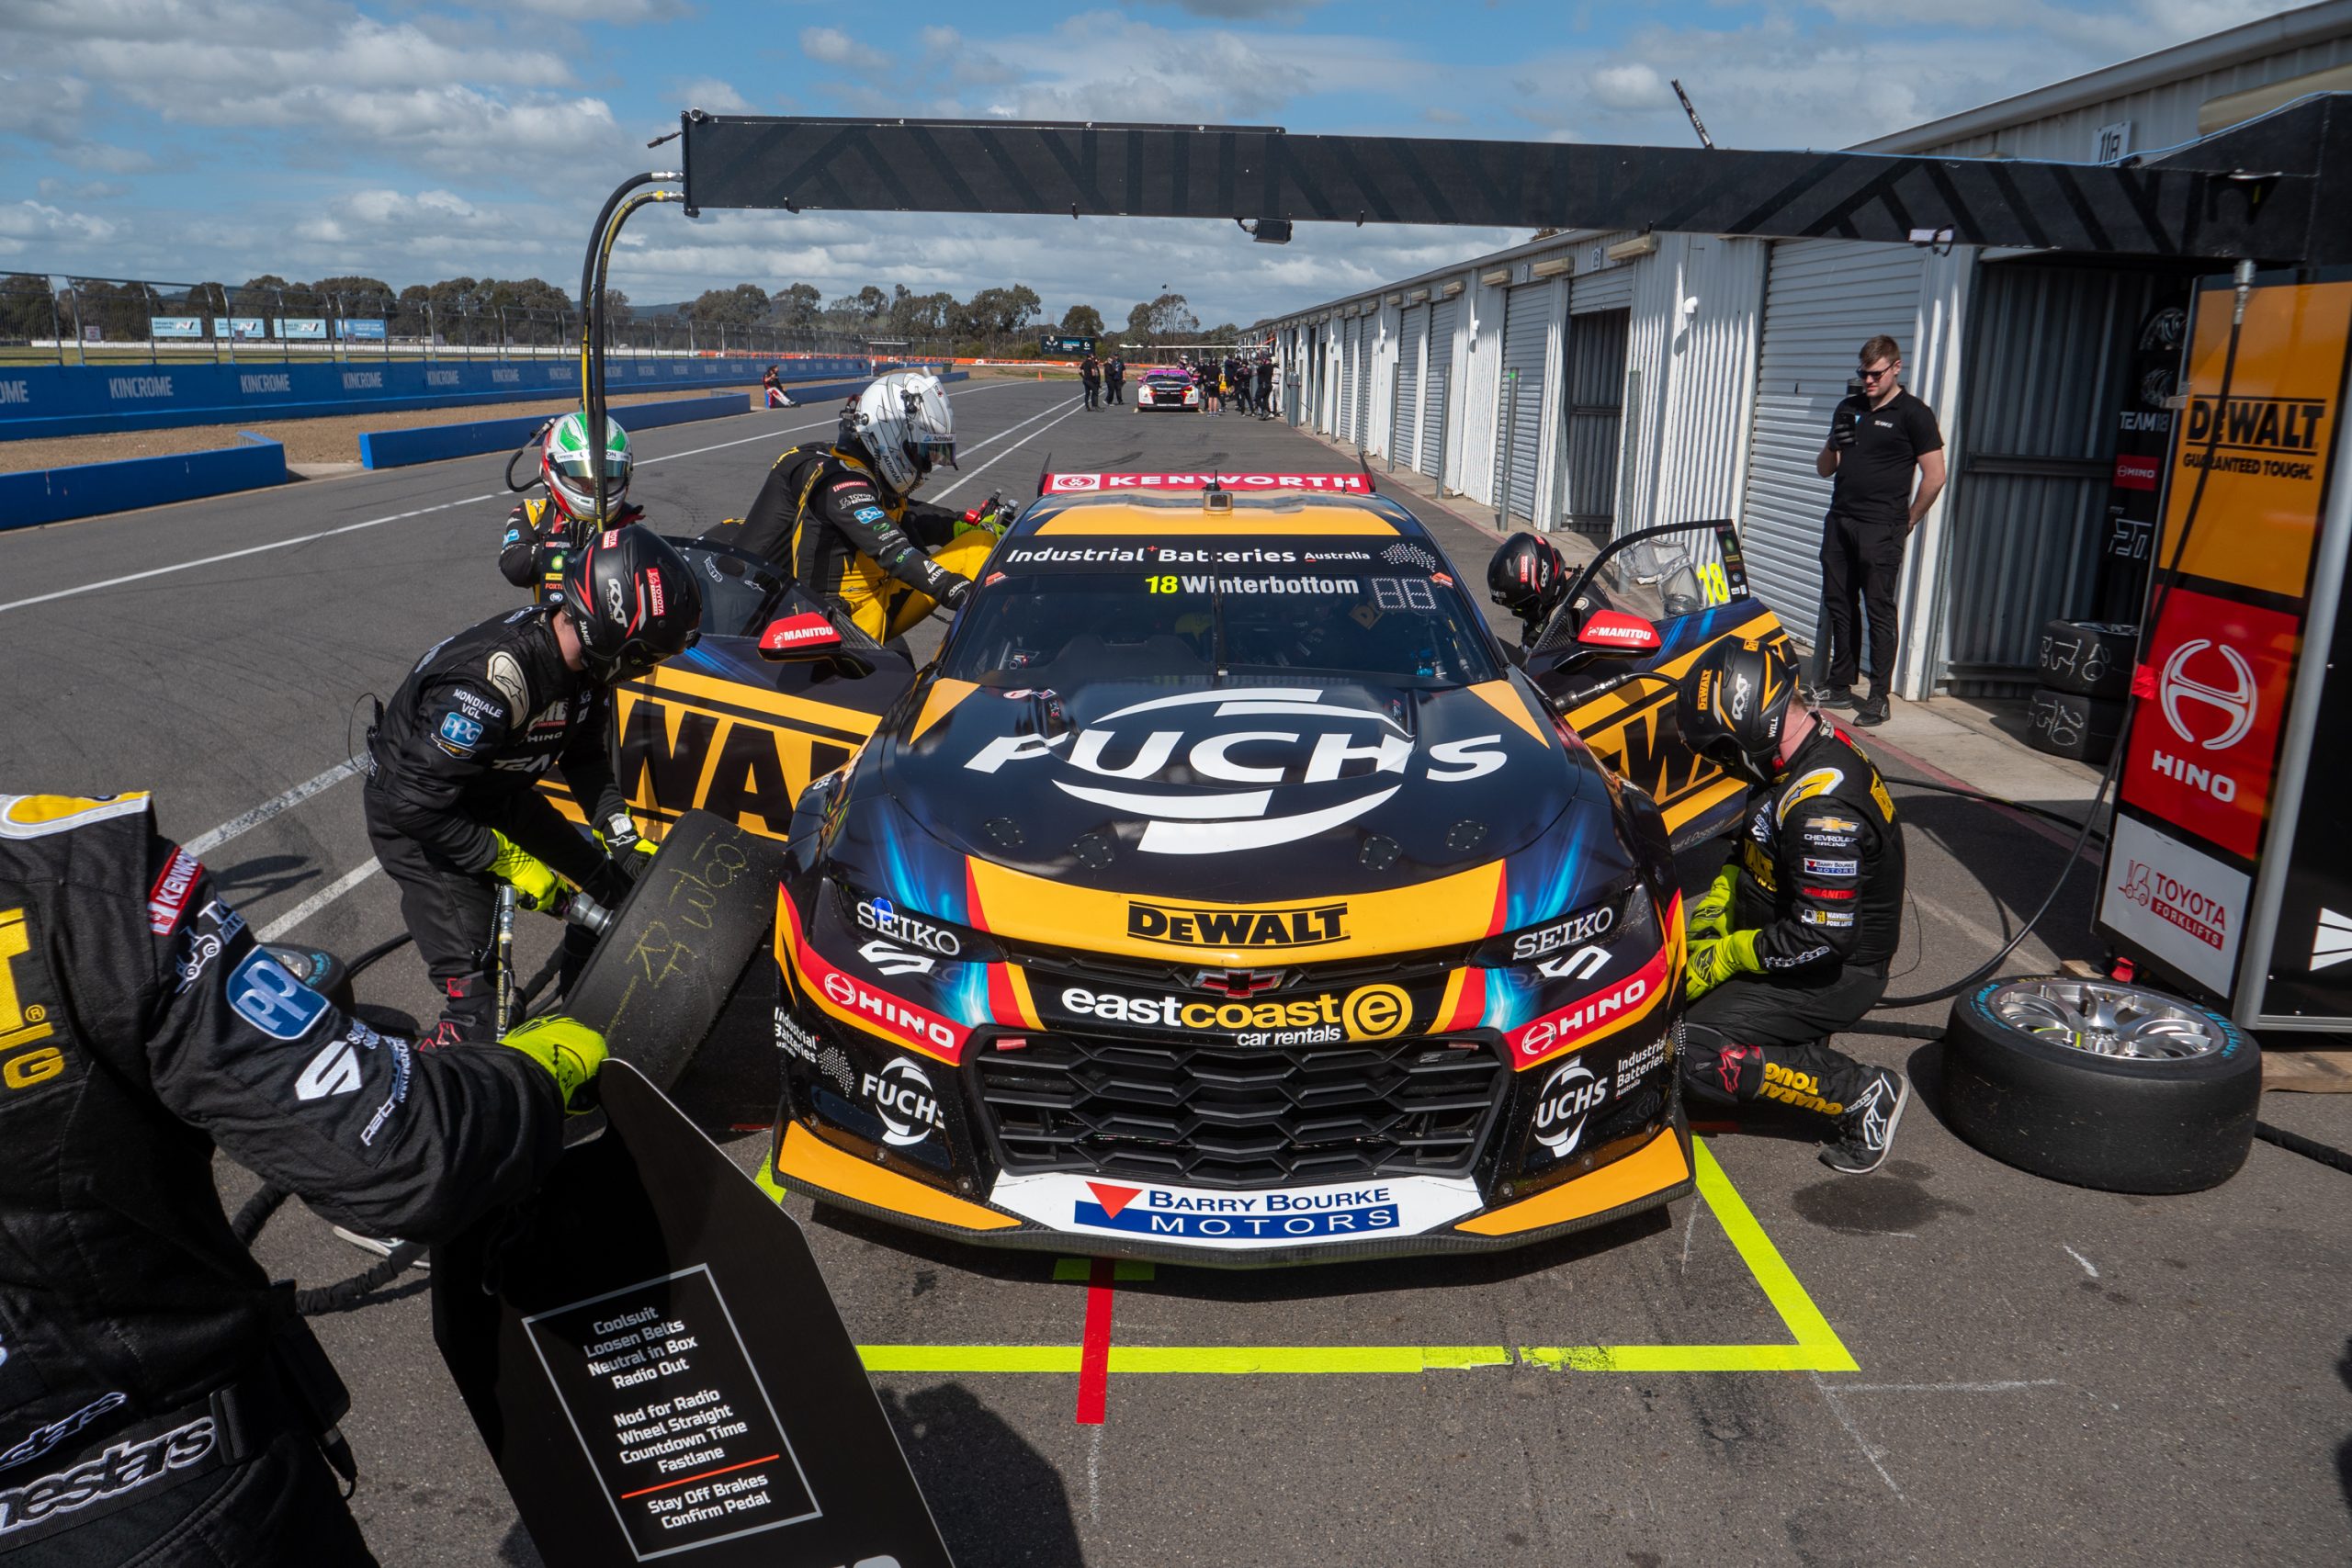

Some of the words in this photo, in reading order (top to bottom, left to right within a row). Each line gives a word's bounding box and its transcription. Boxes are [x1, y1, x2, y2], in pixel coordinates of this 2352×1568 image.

[108, 376, 174, 399] KINCROME
[240, 374, 290, 393] KINCROME
[343, 372, 382, 389] KINCROME
[426, 369, 459, 386] KINCROME
[882, 455, 901, 484] ActronAir
[1109, 476, 1362, 489] KENWORTH
[1006, 547, 1145, 563] Industrial
[1304, 550, 1371, 561] Australia
[654, 583, 664, 615] TOYOTA
[1145, 575, 1179, 594] 18
[1181, 575, 1360, 594] Winterbottom
[1697, 563, 1728, 604] 18
[579, 620, 593, 646] JAMIE
[784, 626, 833, 641] MANITOU
[1598, 626, 1652, 641] MANITOU
[452, 688, 503, 718] MONDIALE
[1697, 669, 1712, 710] DEWALT
[443, 716, 481, 741] PPG
[461, 703, 481, 720] VGL
[1767, 716, 1779, 739] WILL
[526, 731, 563, 743] HINO
[963, 728, 1509, 784] FUCHS
[2151, 750, 2236, 803] HINO
[1804, 833, 1858, 842] CHEVROLET
[155, 849, 199, 907] KENWO
[2155, 872, 2227, 931] TOYOTA
[856, 901, 960, 956] SEIKO
[1128, 905, 1349, 946] DEWALT
[1512, 907, 1613, 961] SEIKO
[2155, 902, 2221, 947] FORKLIFTS
[237, 959, 311, 1031] PP
[1061, 987, 1341, 1029] eastcoast
[1559, 979, 1646, 1037] HINO
[774, 1007, 817, 1051] Industrial
[858, 991, 956, 1049] HINO
[1237, 1031, 1268, 1047] car
[1272, 1025, 1341, 1046] rentals
[1618, 1032, 1667, 1073] Industrial
[1617, 1052, 1664, 1089] Batteries
[1765, 1062, 1818, 1095] TOUG
[1535, 1077, 1609, 1129] UCHS
[1148, 1190, 1258, 1213] BARRY
[1266, 1187, 1390, 1212] BOURKE
[1150, 1210, 1393, 1236] MOTORS
[593, 1306, 660, 1335] Coolsuit
[583, 1332, 641, 1359] Loosen
[641, 1319, 685, 1342] Belts
[587, 1348, 647, 1377] Neutral
[647, 1346, 665, 1359] in
[665, 1336, 698, 1355] Box
[611, 1366, 658, 1390] Radio
[658, 1357, 690, 1377] Out
[613, 1408, 646, 1427] Nod
[647, 1402, 672, 1419] for
[673, 1389, 721, 1412] Radio
[616, 1421, 668, 1446] Wheel
[668, 1404, 734, 1432] Straight
[619, 1431, 707, 1465] Countdown
[706, 1421, 749, 1441] Time
[657, 1447, 726, 1474] Fastlane
[647, 1495, 683, 1515] Stay
[684, 1486, 710, 1505] Off
[712, 1474, 769, 1498] Brakes
[661, 1504, 724, 1529] Confirm
[724, 1490, 772, 1514] Pedal
